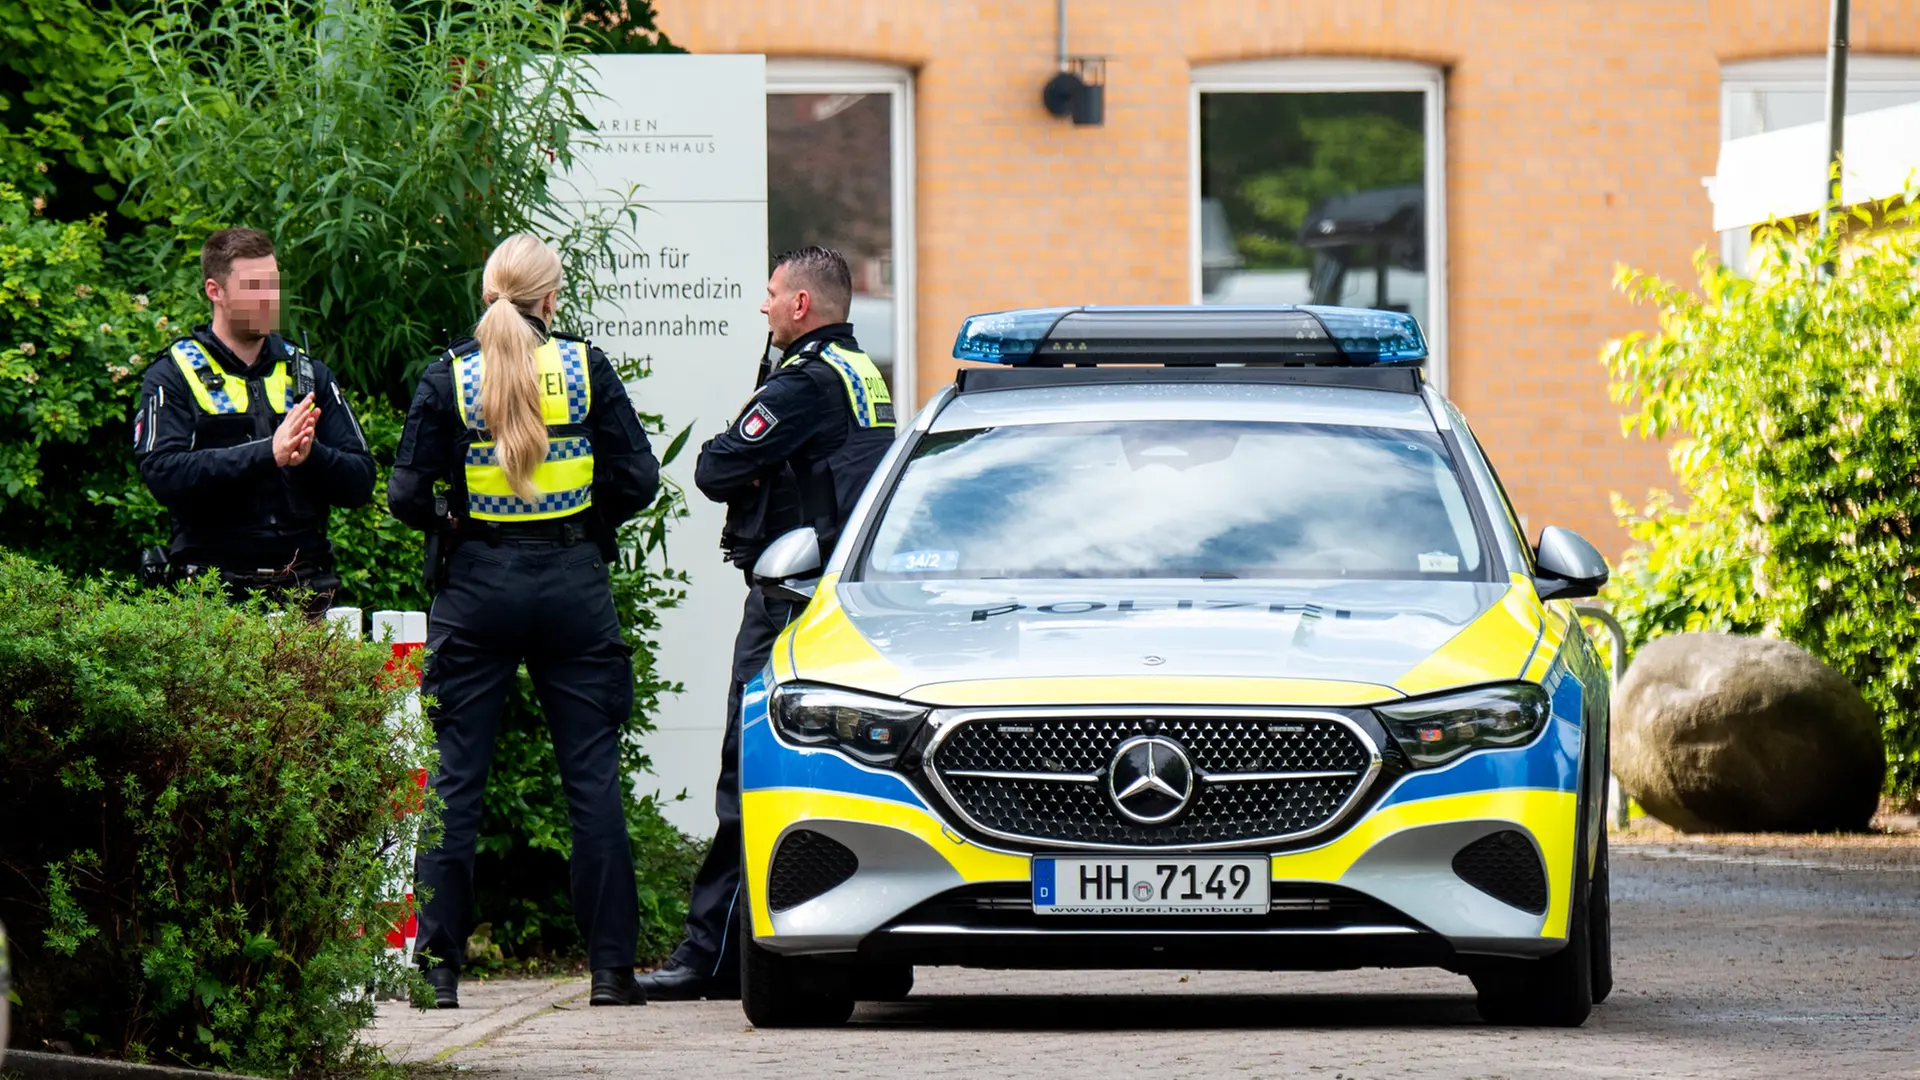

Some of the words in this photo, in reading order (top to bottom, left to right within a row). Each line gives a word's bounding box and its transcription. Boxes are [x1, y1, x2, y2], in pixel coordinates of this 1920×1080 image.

[599, 119, 658, 132] ARIEN
[659, 247, 690, 269] für
[583, 314, 729, 336] arenannahme
[905, 553, 941, 569] 34/2
[971, 599, 1352, 621] POLIZEI
[1040, 887, 1049, 897] D
[1080, 865, 1128, 899] HH
[1156, 864, 1251, 899] 7149
